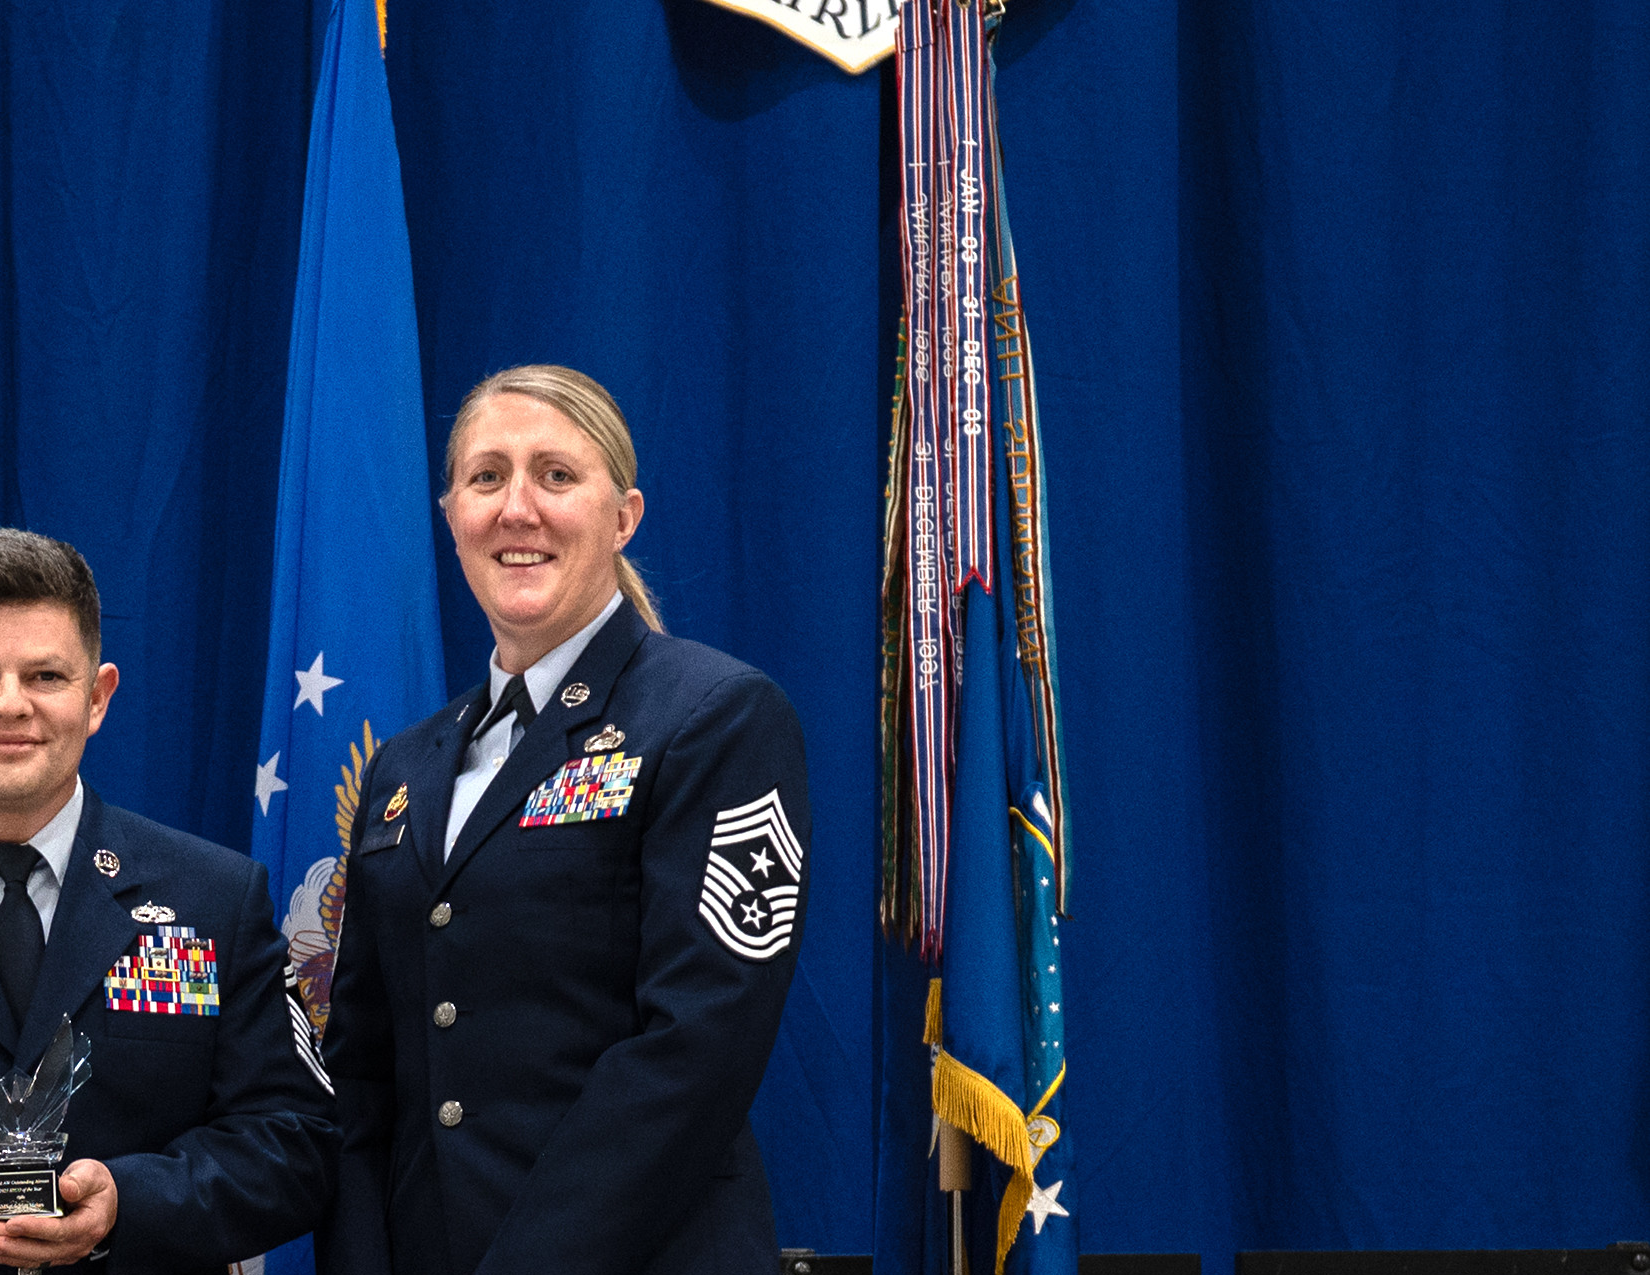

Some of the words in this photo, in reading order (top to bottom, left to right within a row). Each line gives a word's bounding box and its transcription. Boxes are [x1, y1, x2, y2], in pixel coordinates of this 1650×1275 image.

[962, 138, 978, 146] 1
[960, 168, 979, 214] JAN
[961, 236, 979, 263] 03
[962, 296, 981, 318] 31
[963, 340, 981, 384] DEC
[963, 409, 981, 435] 03
